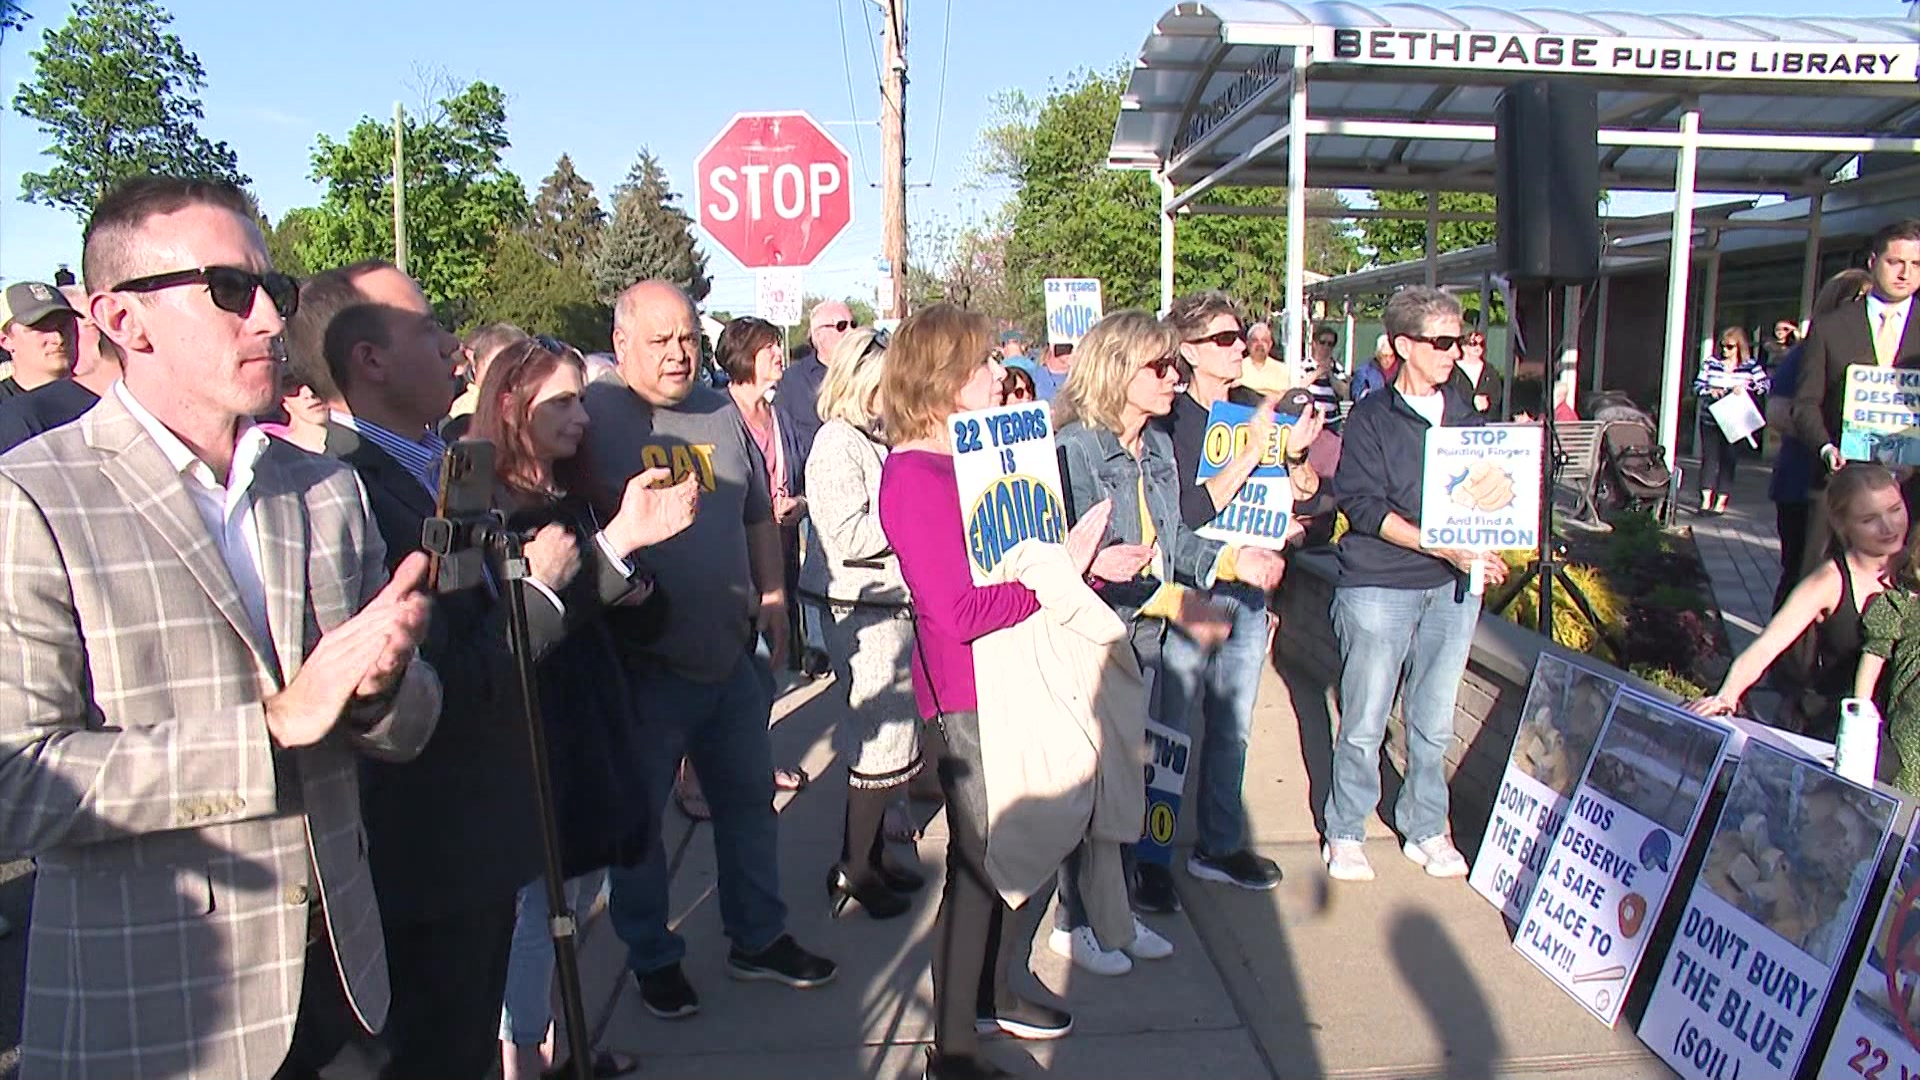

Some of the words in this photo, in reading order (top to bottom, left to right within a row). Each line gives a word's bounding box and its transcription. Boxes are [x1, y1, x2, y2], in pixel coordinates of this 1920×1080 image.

[1334, 29, 1598, 66] BETHPAGE
[1612, 47, 1736, 72] PUBLIC
[1750, 52, 1899, 75] LIBRARY
[708, 162, 841, 222] STOP
[1853, 369, 1896, 386] OUR
[1900, 373, 1920, 387] KI
[1854, 388, 1920, 407] DESER
[954, 418, 983, 454] 22
[985, 407, 1048, 448] YEARS
[1437, 447, 1485, 458] Pointing
[1488, 447, 1530, 459] Fingers
[1461, 430, 1508, 446] STOP
[641, 444, 716, 492] CAT
[1000, 448, 1016, 475] IS
[1240, 483, 1268, 506] UR
[969, 478, 1065, 574] ENOUGH
[1427, 527, 1533, 546] SOLUTION
[1446, 516, 1471, 526] And
[1475, 516, 1502, 526] Find
[1505, 517, 1514, 526] A
[1499, 781, 1538, 822] DON'T
[1574, 794, 1615, 831] KIDS
[1491, 815, 1521, 856] THE
[1518, 836, 1547, 875] BLU
[1561, 826, 1638, 888] DESERVE
[1548, 858, 1561, 881] A
[1562, 866, 1606, 910] SAFE
[1535, 887, 1587, 939] PLACE
[1588, 924, 1612, 957] TO
[1523, 919, 1577, 973] PLAY!!!
[1683, 906, 1749, 970] DON'T
[1746, 951, 1819, 1018] BURY
[1671, 951, 1721, 1013] THE
[1717, 988, 1795, 1070] BLUE
[1847, 1036, 1889, 1080] 22
